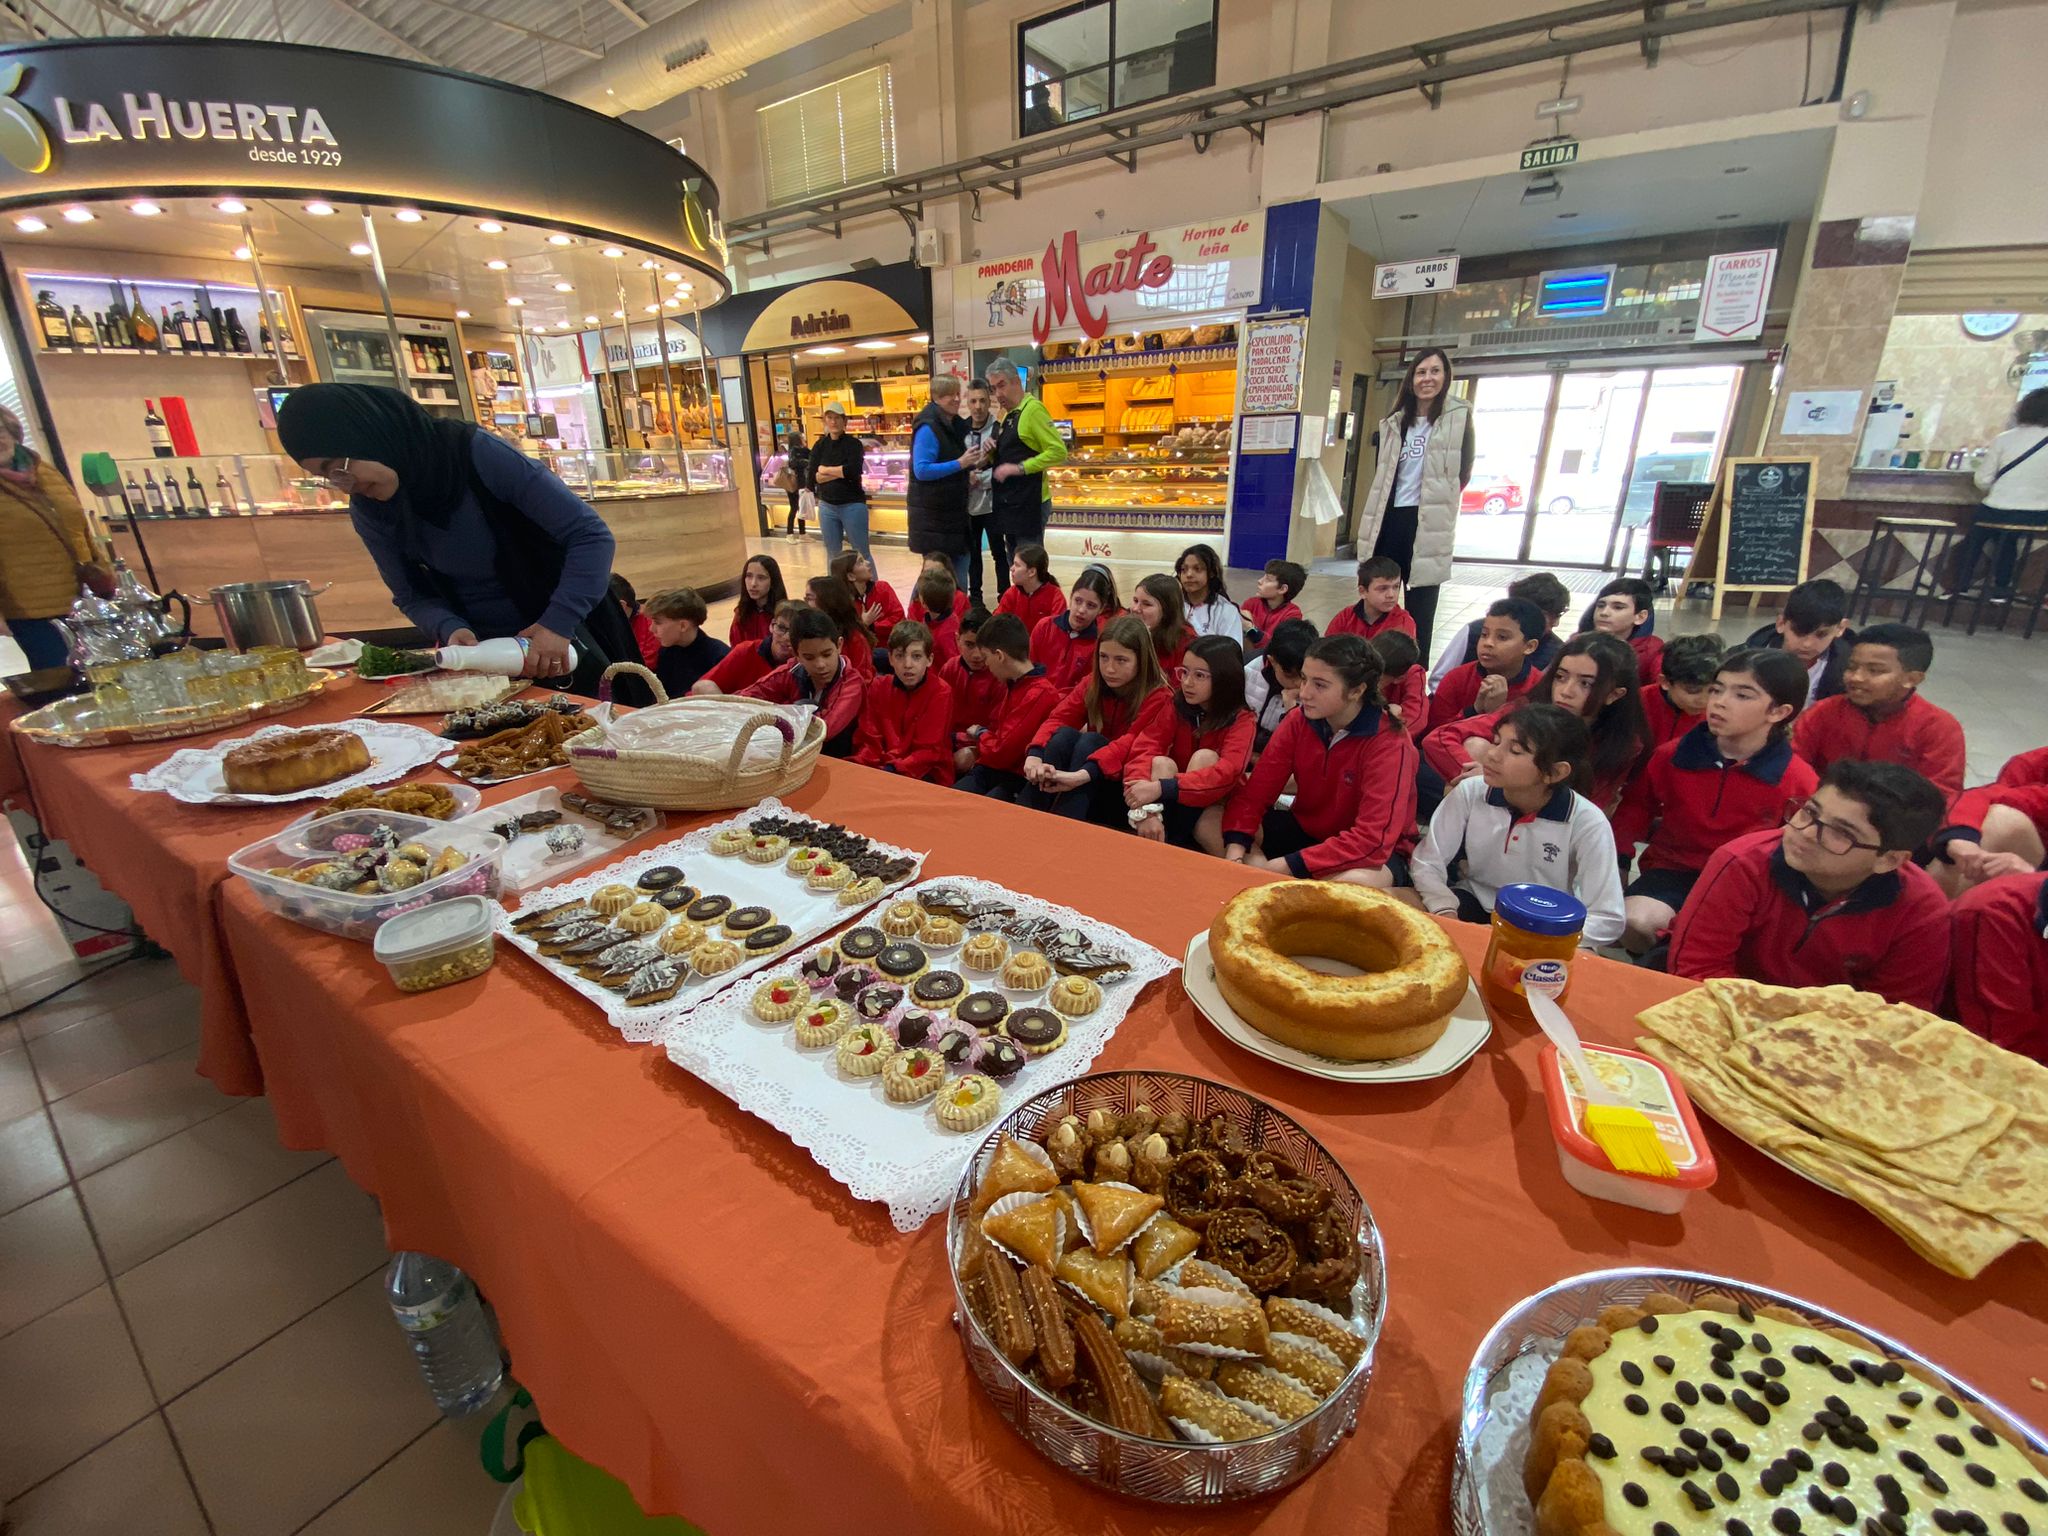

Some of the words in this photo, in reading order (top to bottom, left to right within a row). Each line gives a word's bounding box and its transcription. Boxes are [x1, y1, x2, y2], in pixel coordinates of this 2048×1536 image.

[54, 96, 123, 143] LA
[122, 92, 338, 146] HUERTA
[249, 146, 298, 163] desde
[300, 149, 342, 167] 1929
[1523, 145, 1575, 168] SALIDA
[1182, 227, 1226, 242] Horno
[1231, 219, 1249, 234] de
[1199, 243, 1230, 257] leña
[978, 258, 1034, 278] PANADERIA
[1415, 262, 1448, 274] CARROS
[1719, 257, 1762, 271] CARROS
[1032, 230, 1175, 344] Maite
[791, 308, 851, 337] Adrián
[1252, 347, 1264, 358] PAN
[1266, 345, 1291, 356] CASERO
[1248, 383, 1294, 394] EMPANADILLAS
[1249, 376, 1265, 386] COCA
[1267, 374, 1288, 384] DULCE
[1247, 394, 1262, 403] COCA
[1263, 393, 1271, 403] DE
